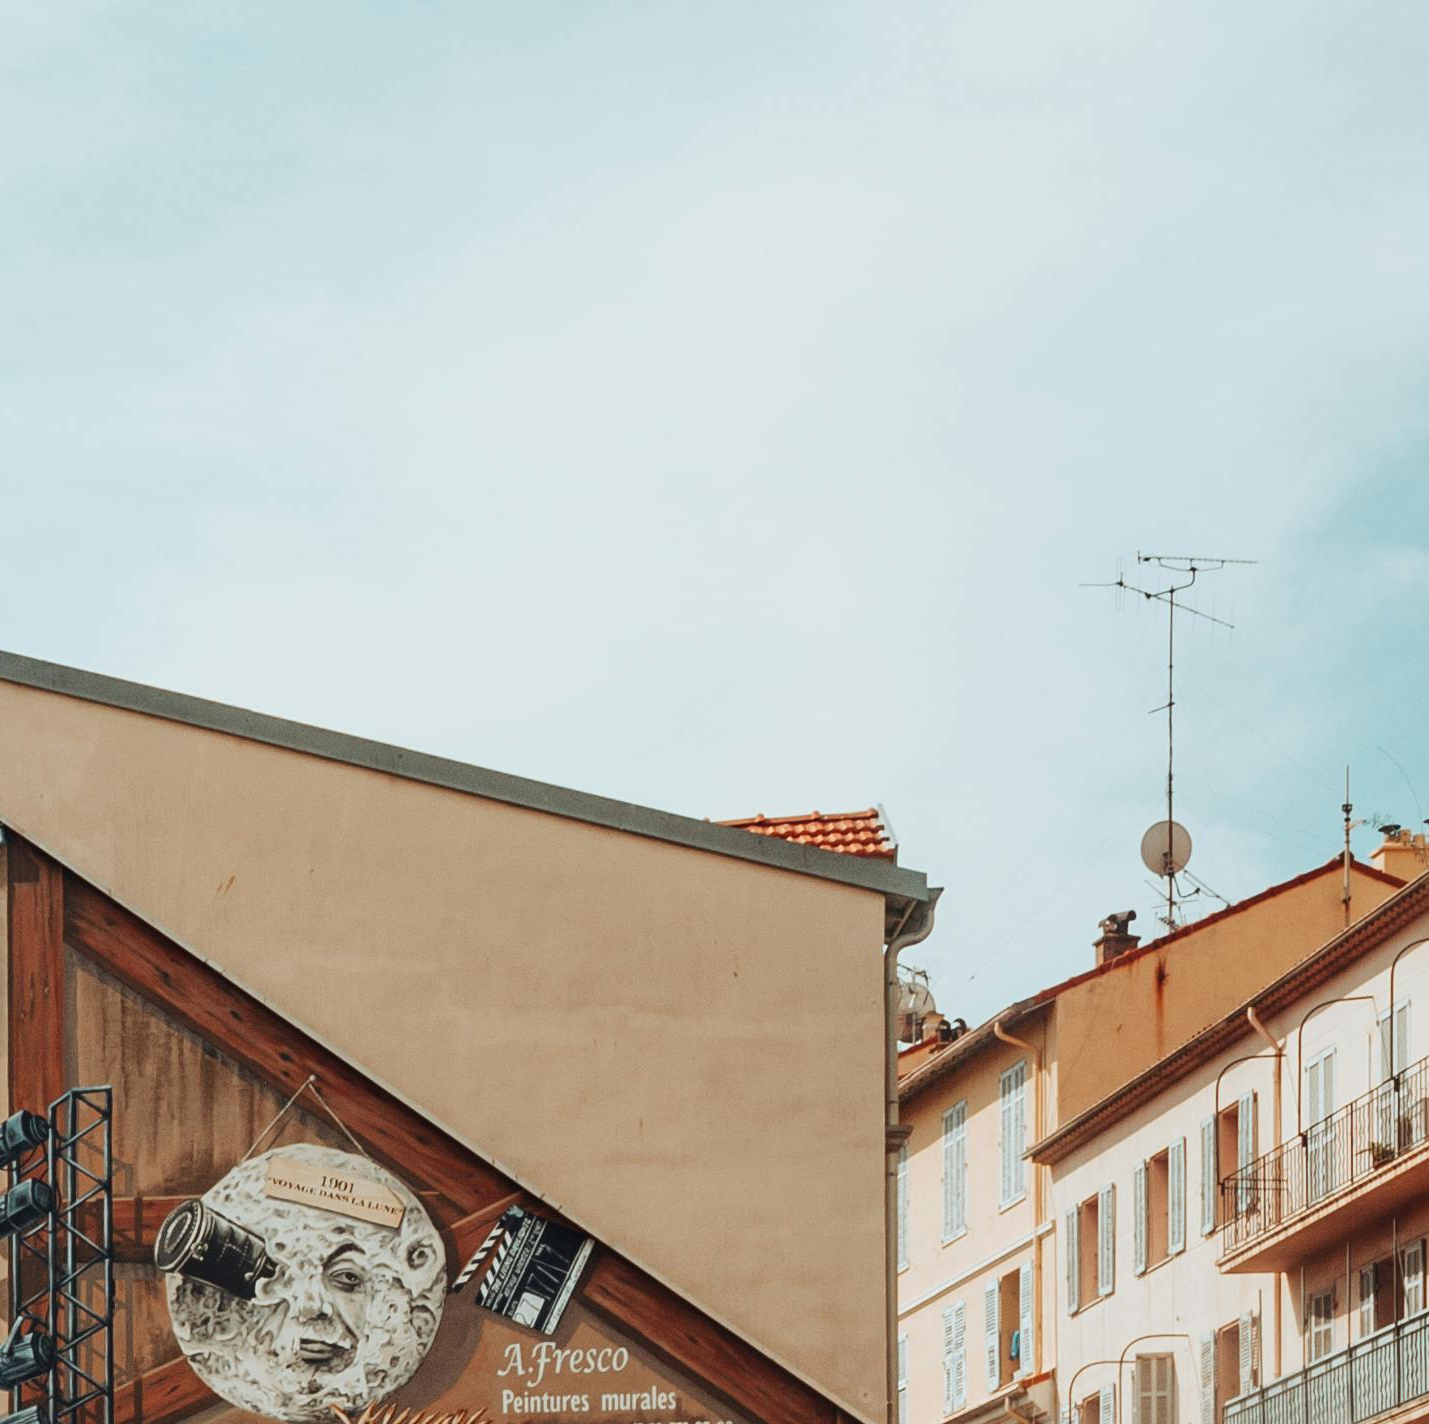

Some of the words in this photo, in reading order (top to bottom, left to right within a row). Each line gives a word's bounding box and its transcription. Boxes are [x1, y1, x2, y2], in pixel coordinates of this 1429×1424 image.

[320, 1175, 355, 1194] 1901
[502, 1389, 590, 1414] Peintures
[601, 1385, 677, 1411] murales
